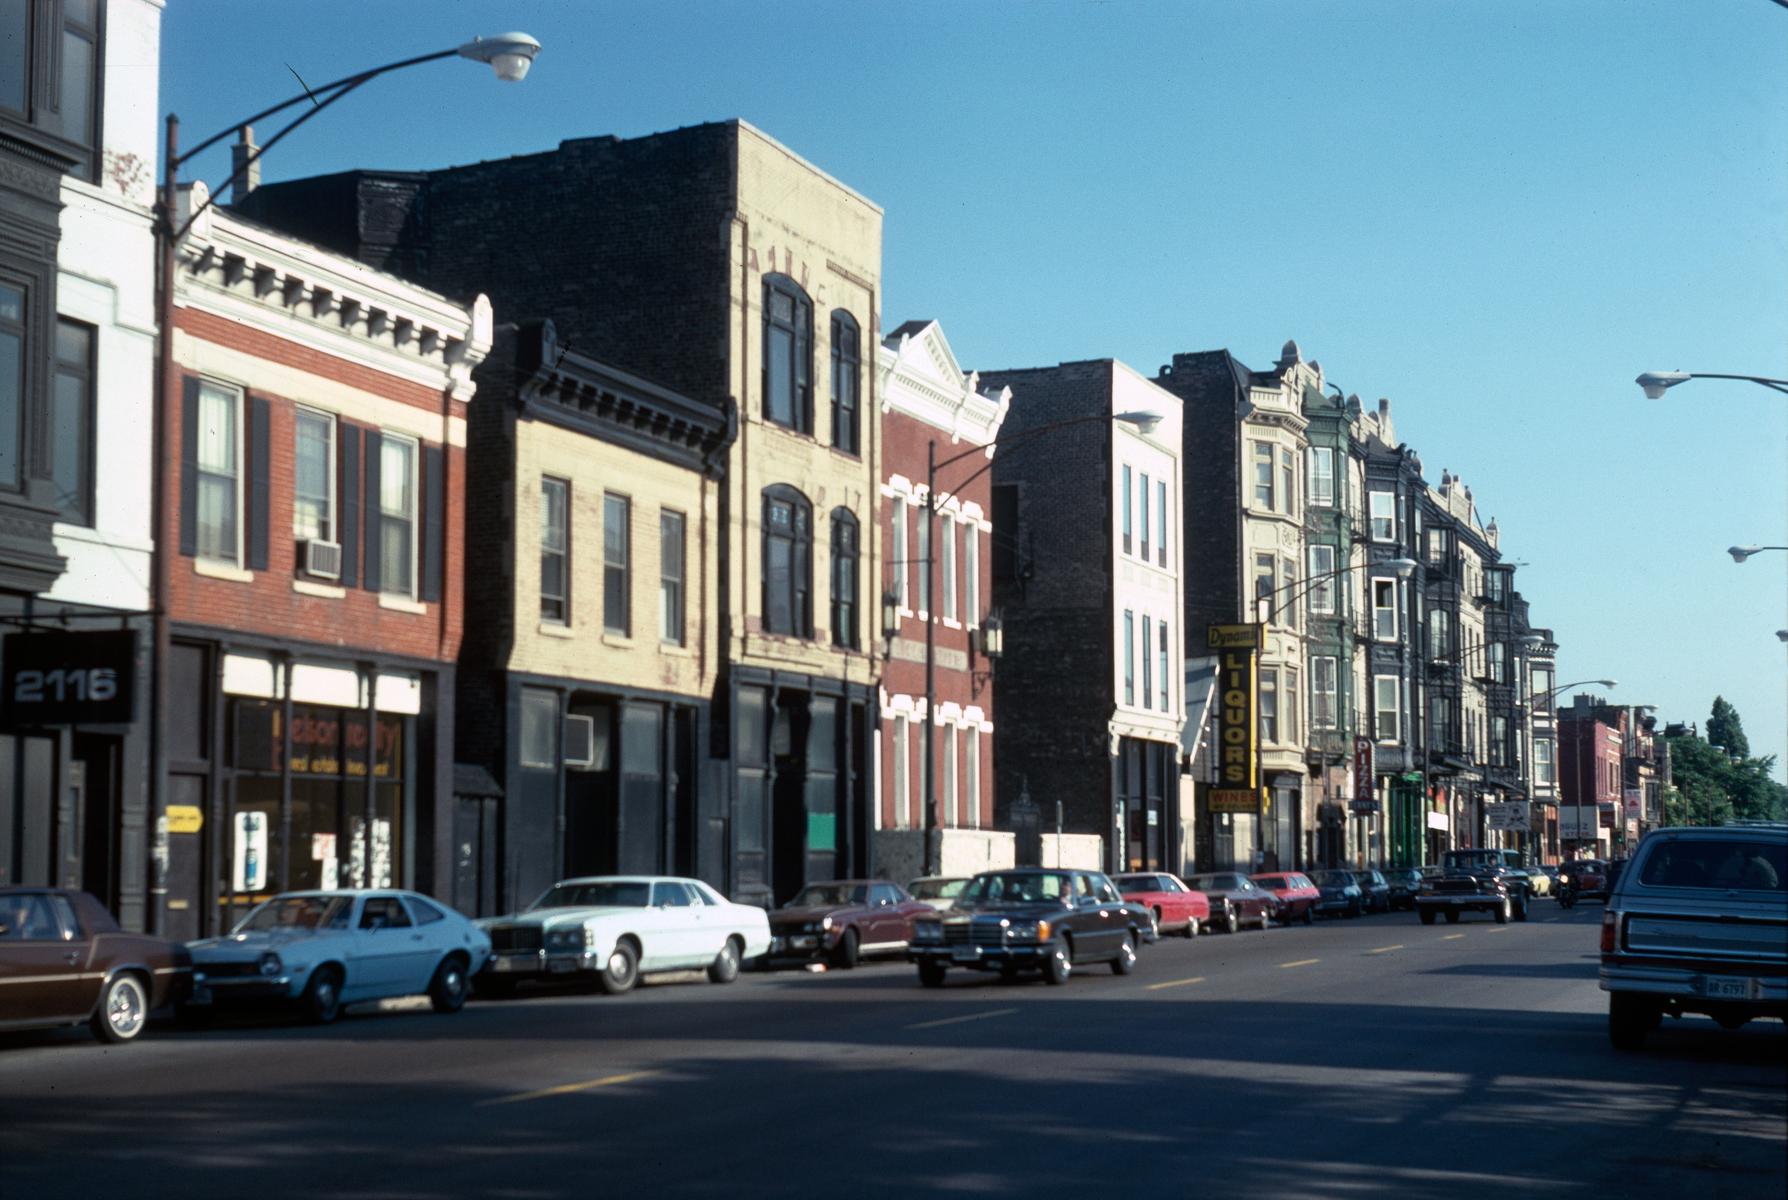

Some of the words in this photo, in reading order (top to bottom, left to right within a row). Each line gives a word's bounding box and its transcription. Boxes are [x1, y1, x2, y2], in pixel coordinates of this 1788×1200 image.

[1210, 628, 1256, 646] Dynami
[14, 668, 118, 702] 2116
[1224, 653, 1246, 782] LIQUORS
[1358, 741, 1369, 798] PIZZA
[1212, 791, 1257, 803] WINES
